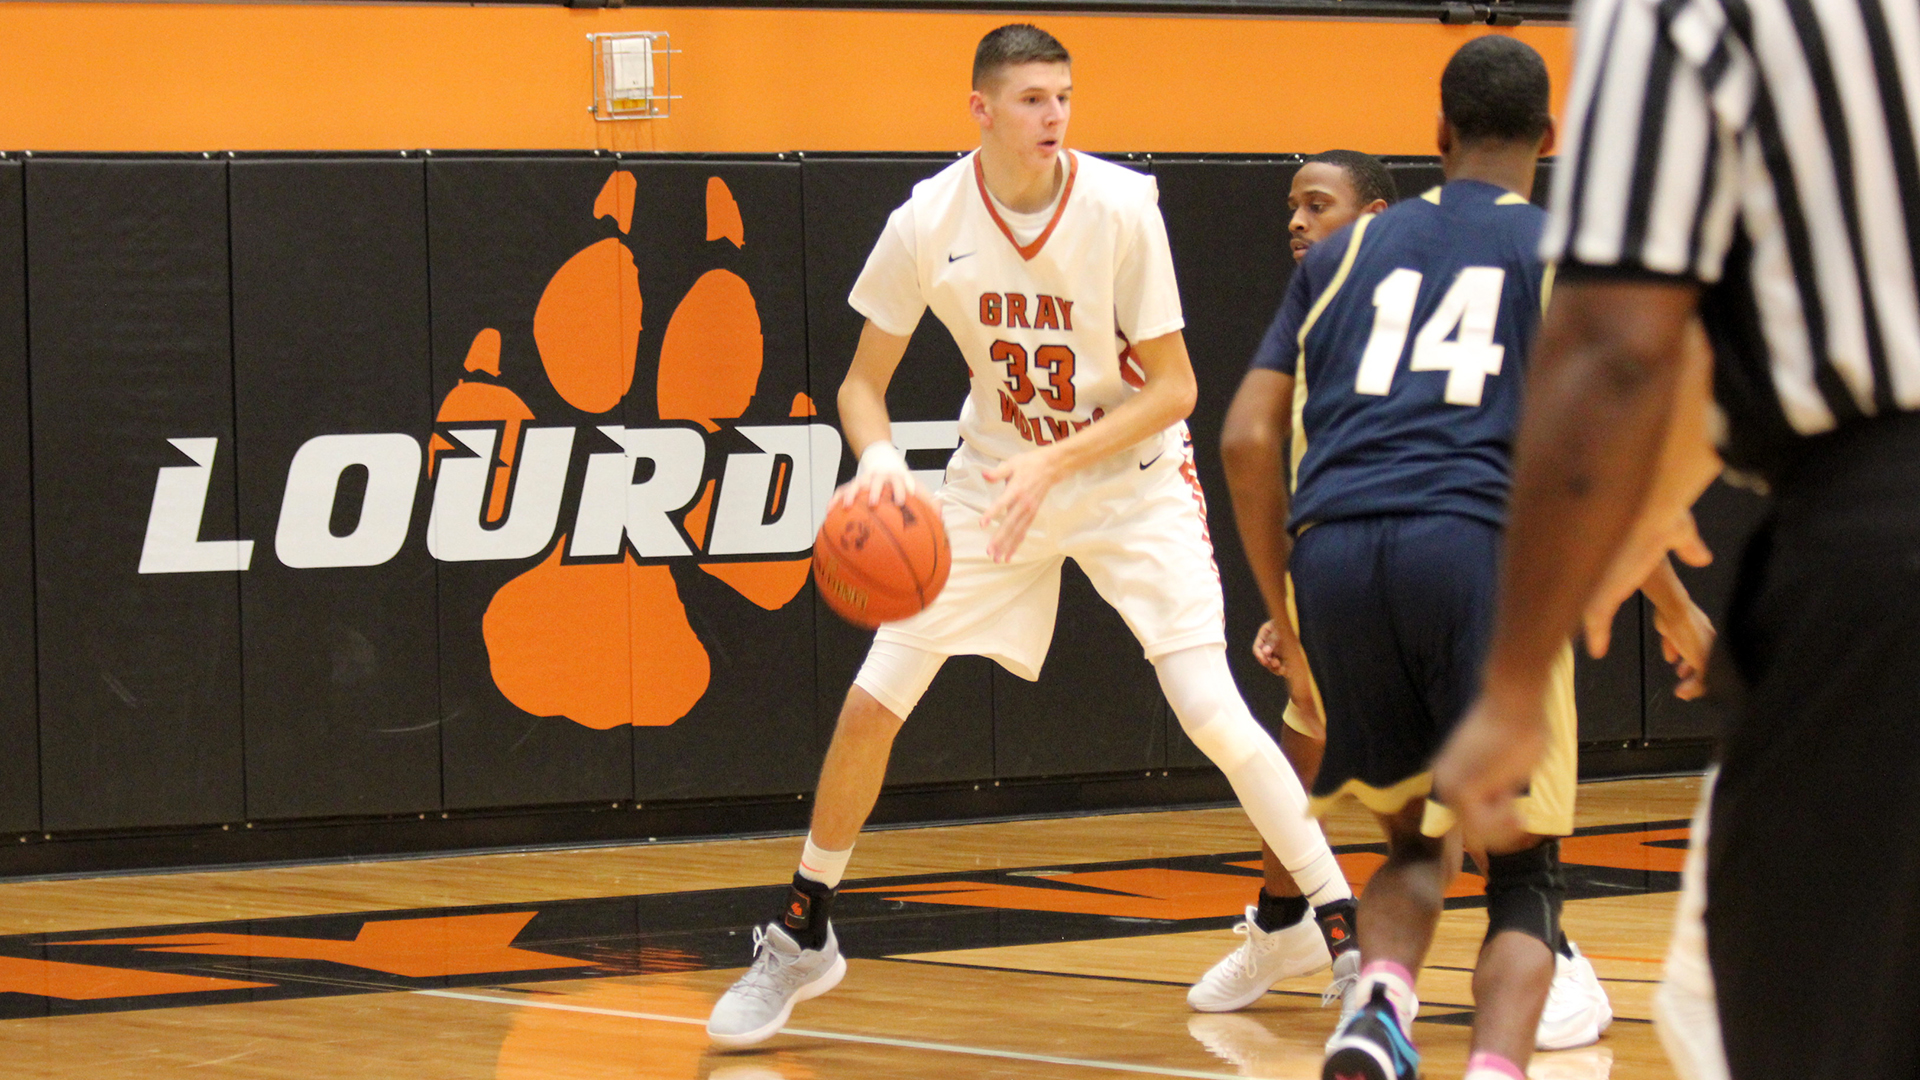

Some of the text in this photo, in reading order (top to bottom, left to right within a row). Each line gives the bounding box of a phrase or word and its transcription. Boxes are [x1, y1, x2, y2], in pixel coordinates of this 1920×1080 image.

[979, 292, 1074, 331] GRAY
[1355, 266, 1505, 406] 14
[990, 340, 1075, 412] 33
[138, 421, 959, 575] LOURD
